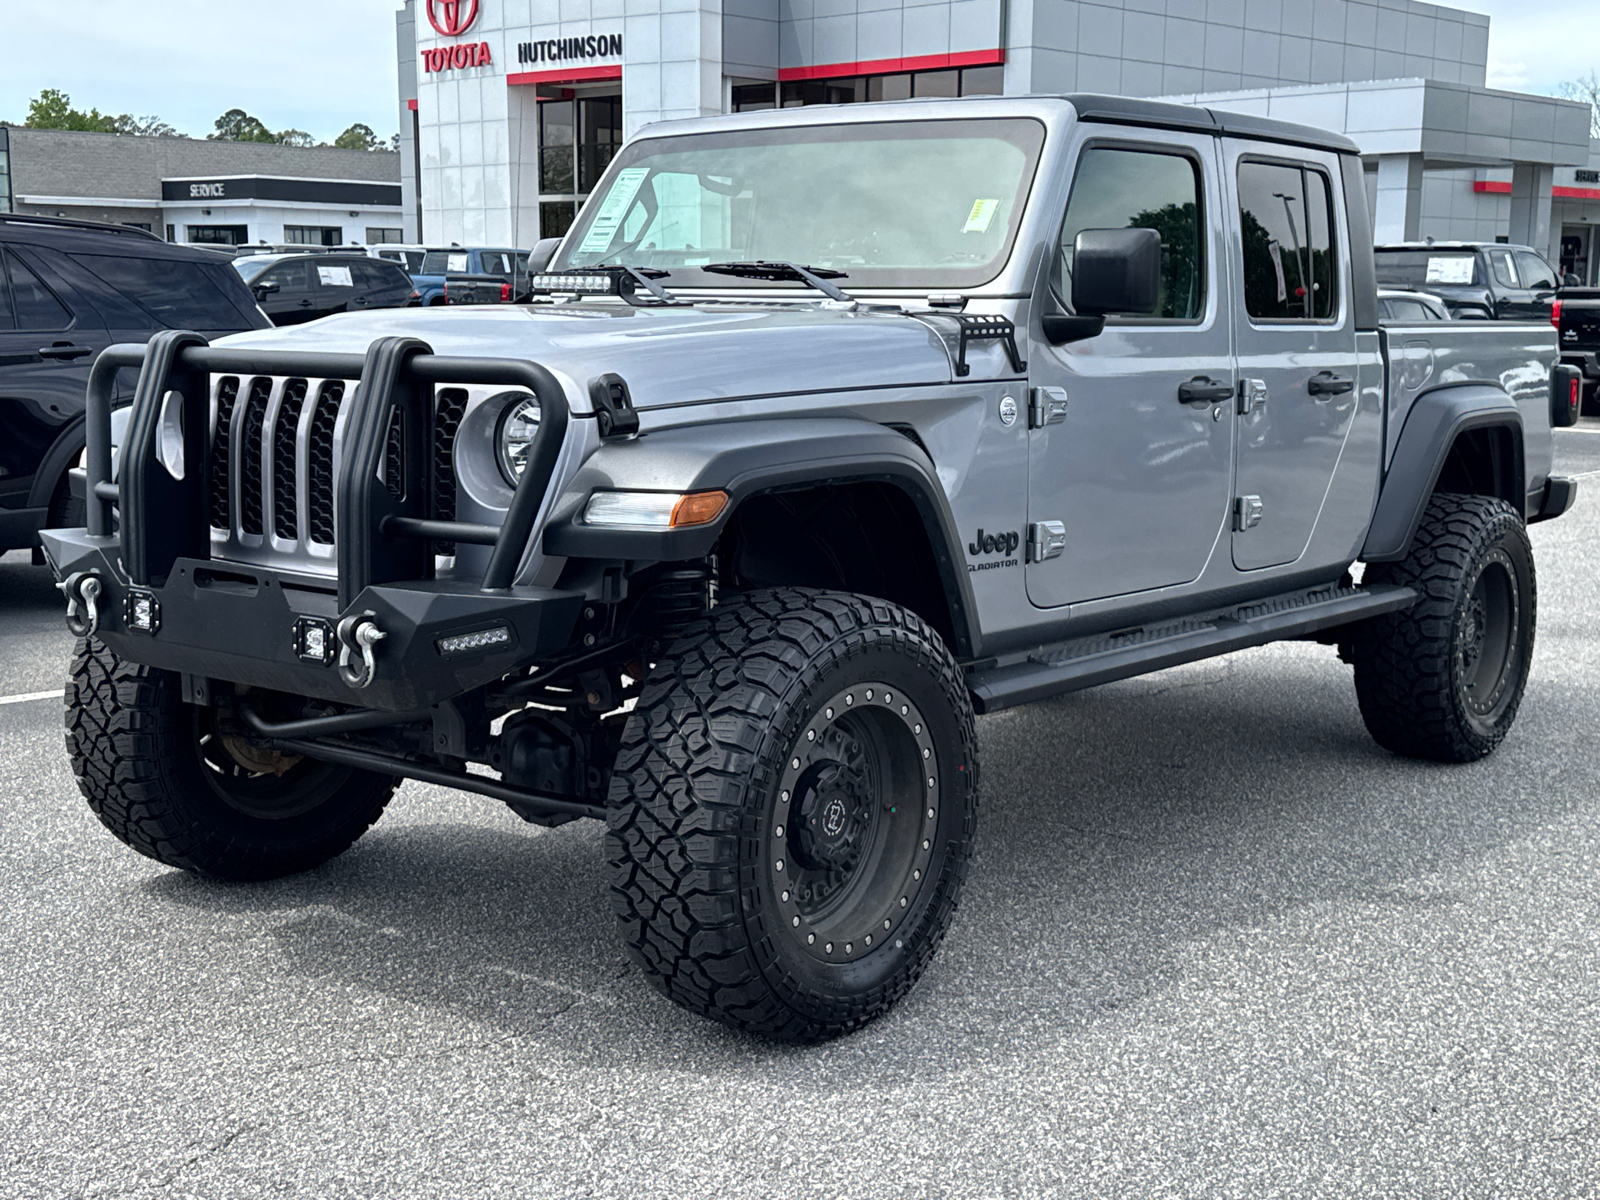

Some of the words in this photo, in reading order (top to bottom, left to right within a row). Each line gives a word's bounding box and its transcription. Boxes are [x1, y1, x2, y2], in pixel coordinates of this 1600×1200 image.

[421, 41, 492, 73] TOYOTA
[518, 33, 622, 63] HUTCHINSON
[190, 182, 225, 198] SERVICE
[969, 528, 1019, 557] Jeep
